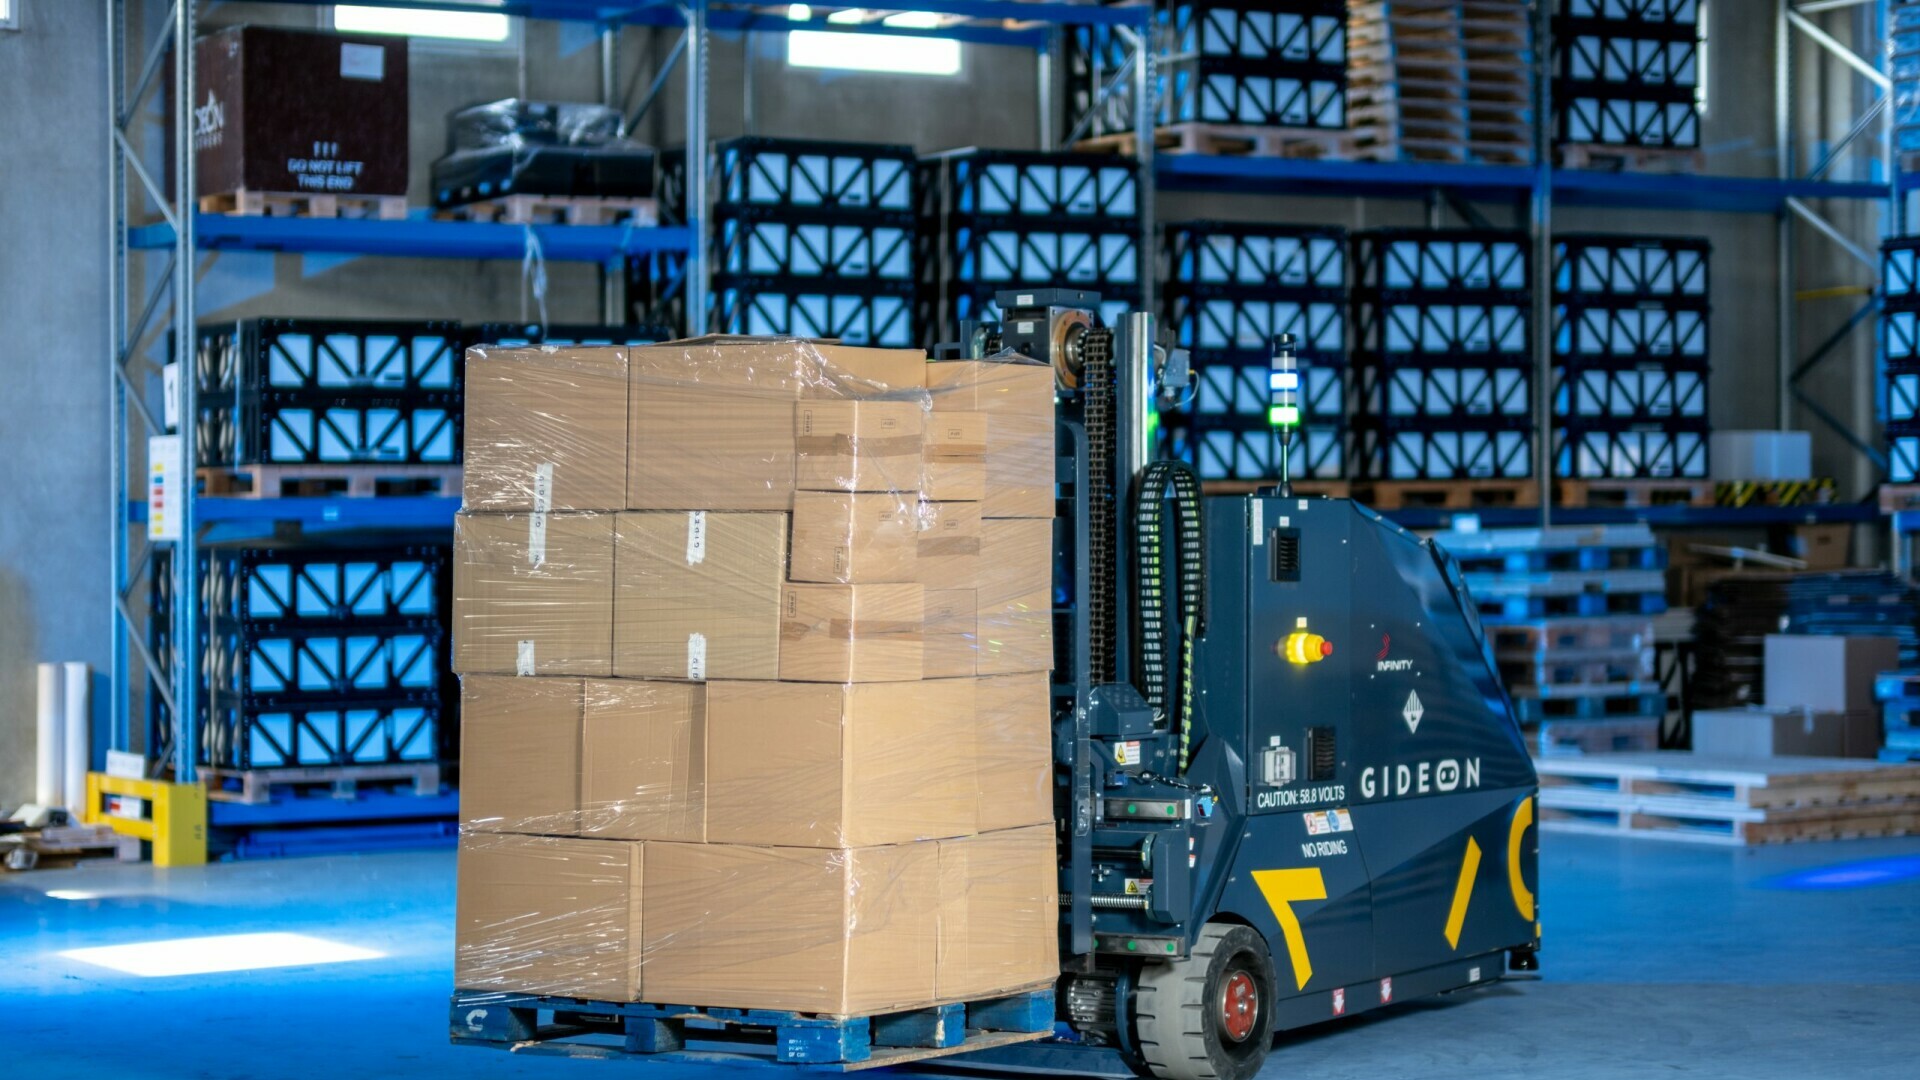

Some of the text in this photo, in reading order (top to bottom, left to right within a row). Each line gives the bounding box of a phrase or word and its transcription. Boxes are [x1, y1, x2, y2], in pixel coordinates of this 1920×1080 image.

[288, 158, 364, 176] DO NOT LIFT
[298, 173, 354, 190] THIS END
[1377, 659, 1413, 671] INFINITY
[1361, 757, 1480, 798] GIDEON
[1257, 784, 1346, 808] CAUTION: 58.8 VOLTS
[1301, 839, 1348, 858] NO RIDING
